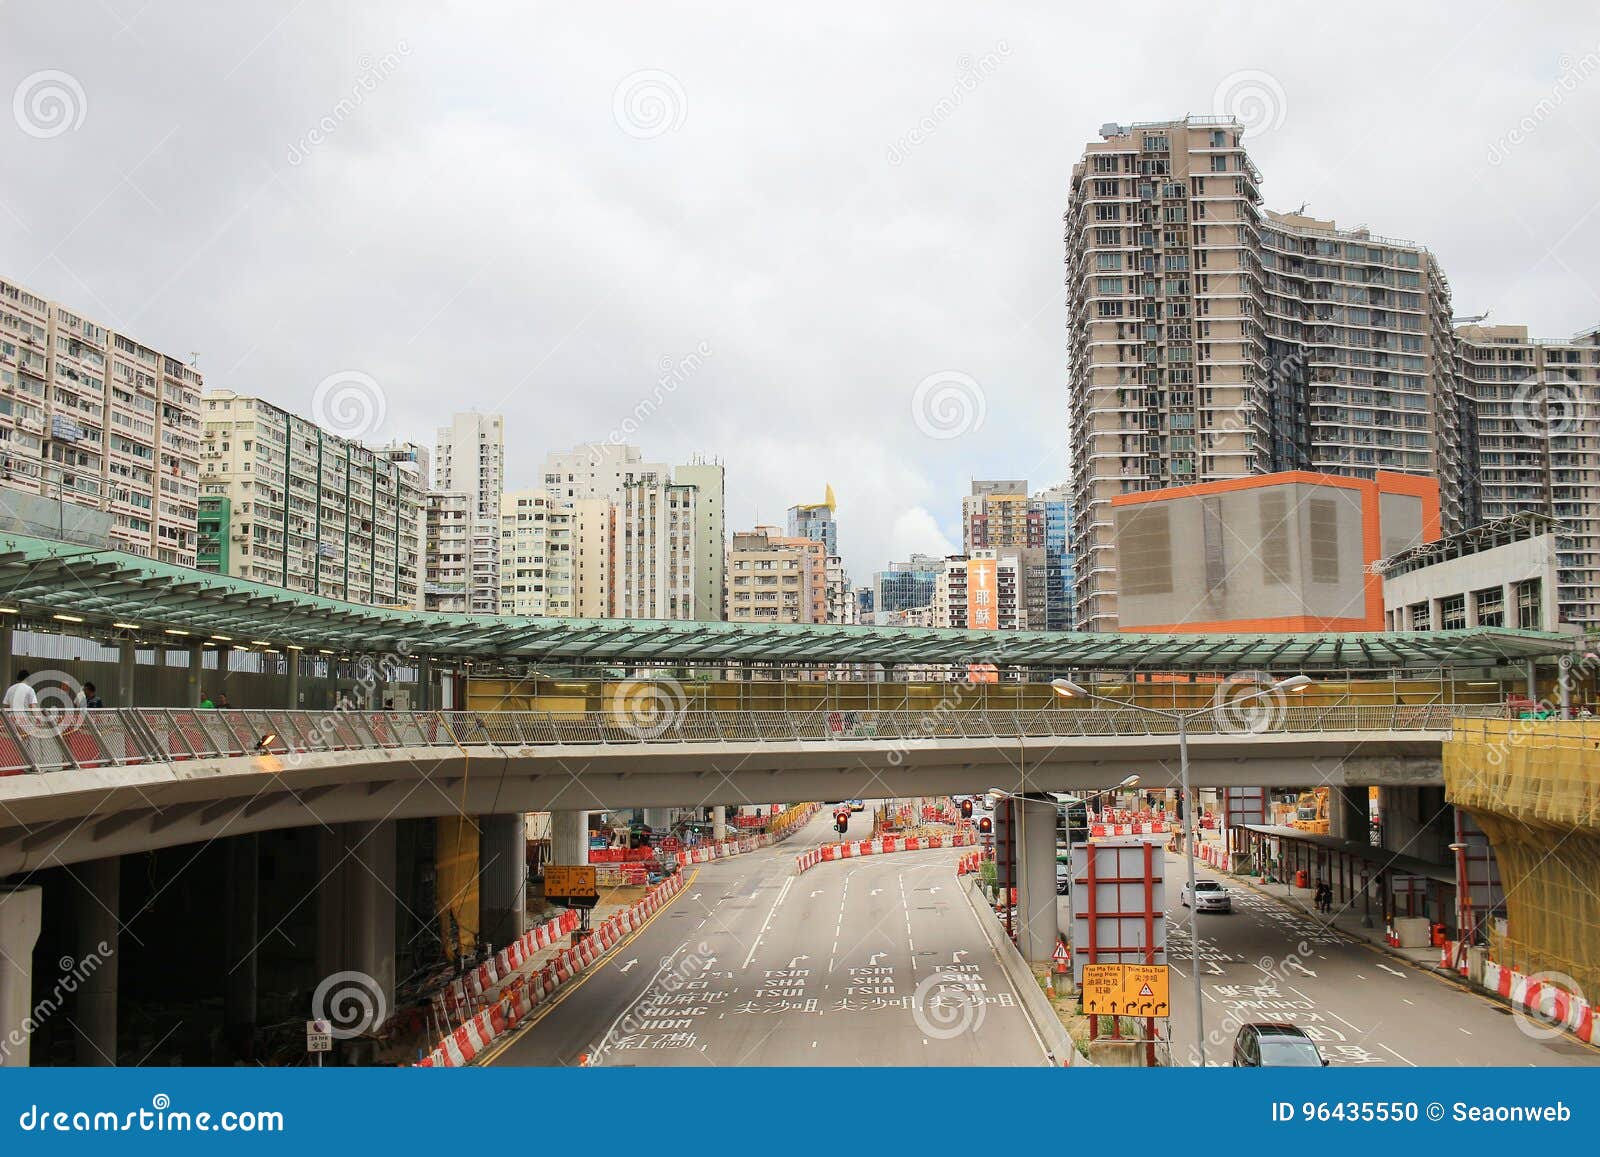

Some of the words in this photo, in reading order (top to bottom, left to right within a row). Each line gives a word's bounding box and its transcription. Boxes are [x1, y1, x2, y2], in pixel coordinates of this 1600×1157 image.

[848, 967, 894, 975] TSIM
[932, 964, 980, 972] TSIM
[763, 969, 810, 977] TSIM
[852, 976, 894, 984] SHA
[942, 974, 984, 982] SHA
[764, 978, 806, 987] SHA
[845, 986, 895, 995] TSUI
[935, 983, 988, 993] TSUI
[754, 988, 804, 998] TSUI
[732, 998, 819, 1014] 尖沙咀
